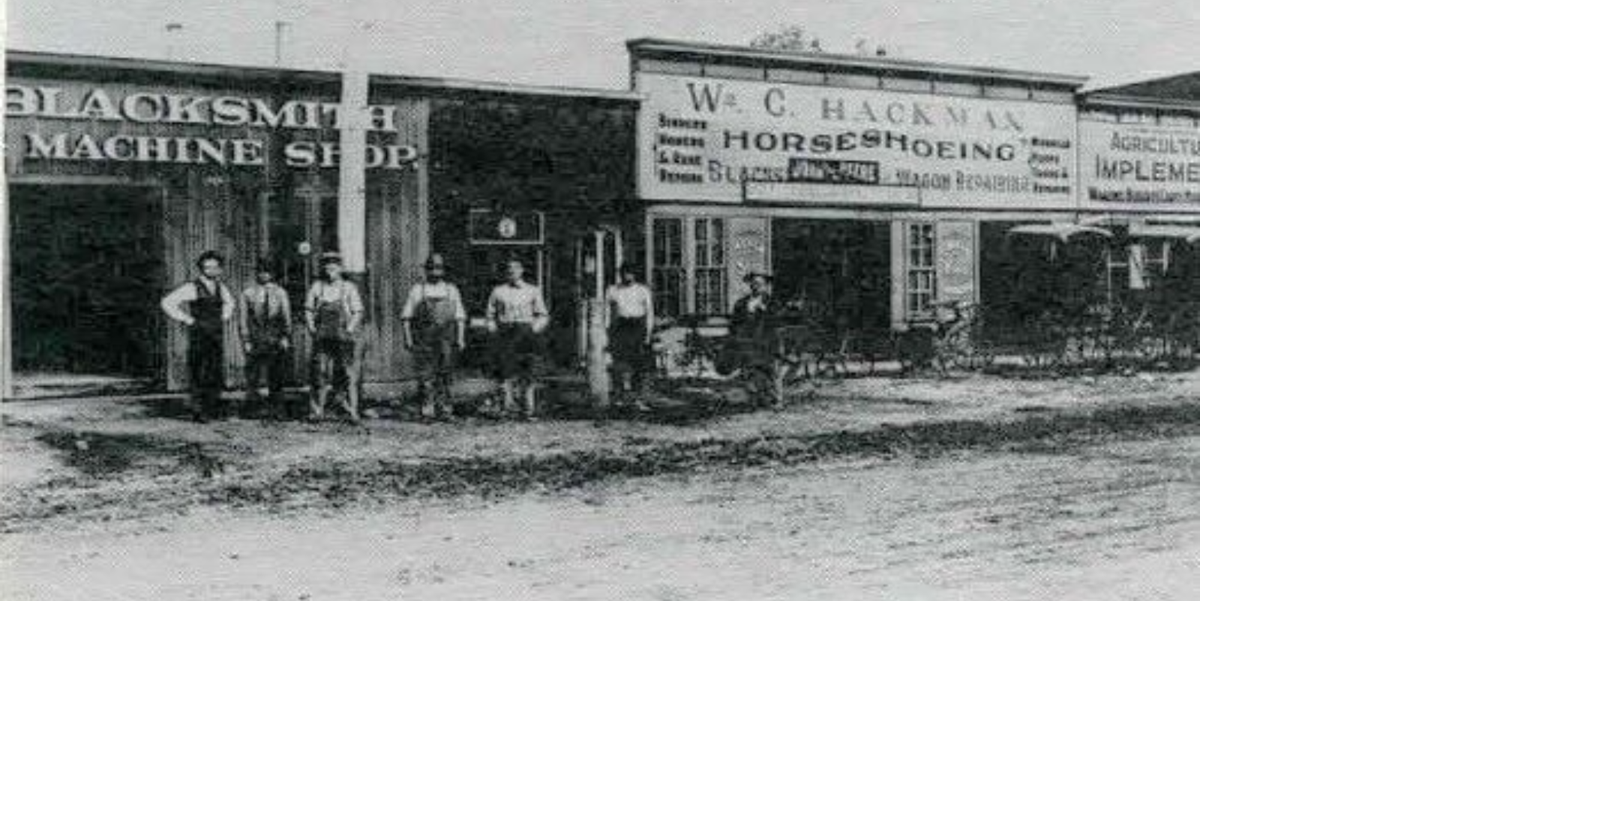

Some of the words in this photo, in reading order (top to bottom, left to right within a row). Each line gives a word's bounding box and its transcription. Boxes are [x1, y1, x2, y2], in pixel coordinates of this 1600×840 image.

[5, 85, 398, 132] BLACKSMITH
[26, 132, 267, 166] MACHINE
[722, 129, 1015, 162] HORSESHOEING
